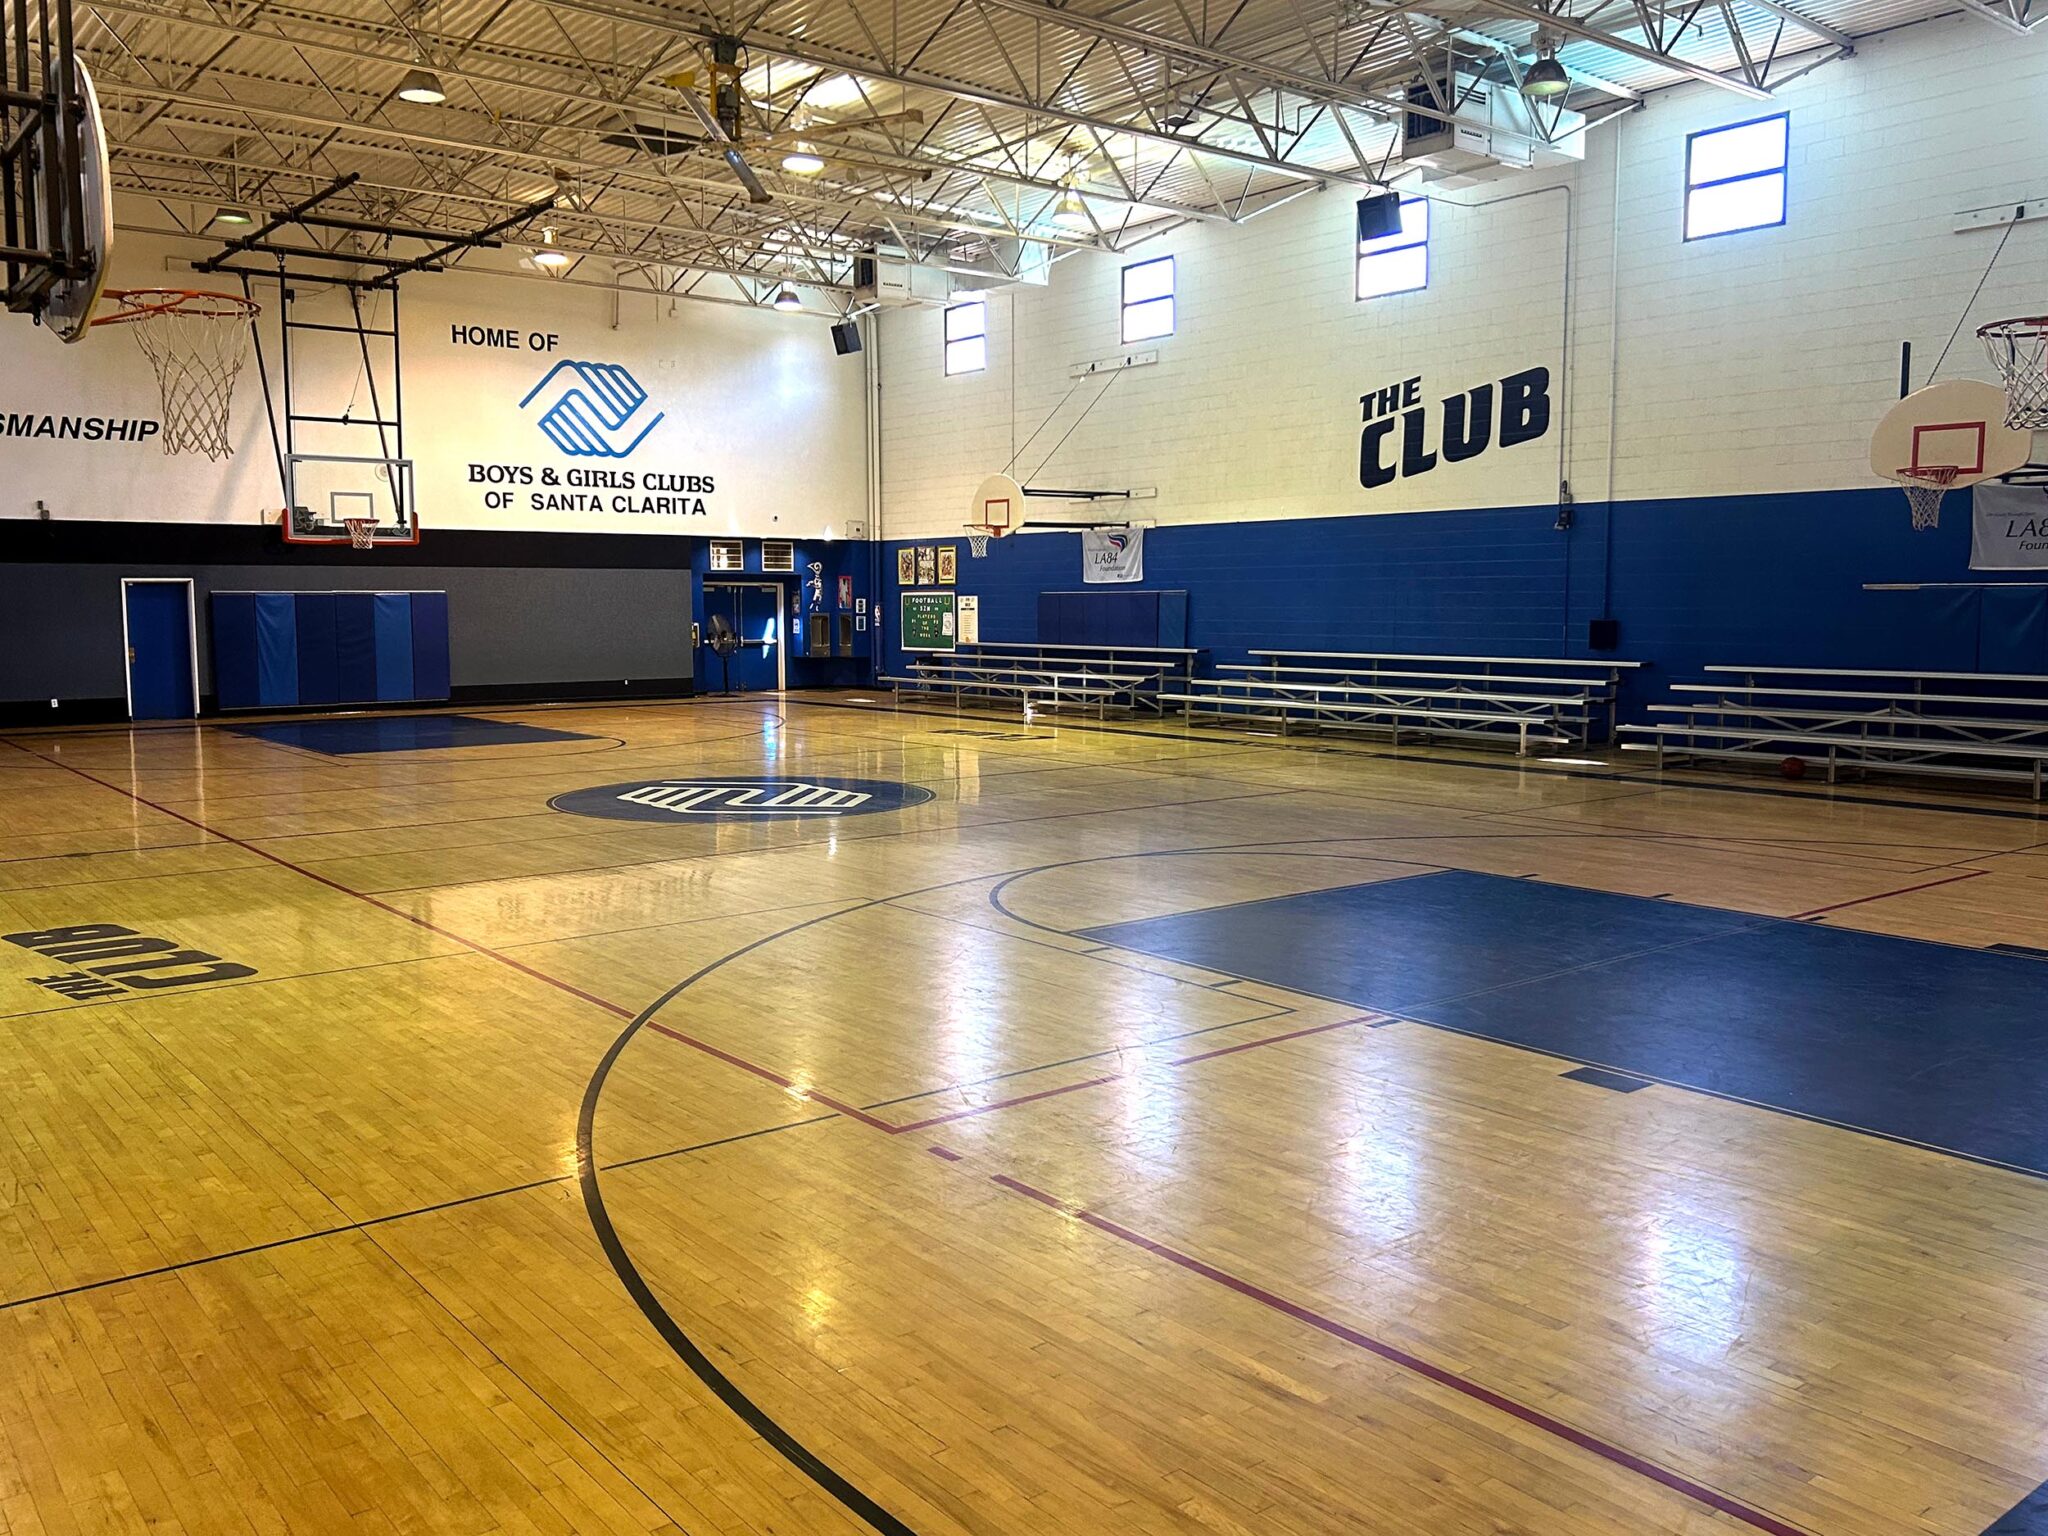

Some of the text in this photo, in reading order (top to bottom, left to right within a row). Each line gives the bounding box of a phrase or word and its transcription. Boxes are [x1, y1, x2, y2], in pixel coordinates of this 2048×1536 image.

[451, 324, 559, 352] HOME OF
[1359, 375, 1422, 422] THE
[0, 413, 160, 442] MANSHIP
[1359, 366, 1550, 489] CLUB
[468, 464, 715, 494] BOYS & GIRLS CLUBS
[484, 491, 707, 516] OF SANTA CLARITA
[1094, 551, 1118, 565] LA84
[1, 923, 259, 989] CLUB
[25, 971, 130, 1000] THE
